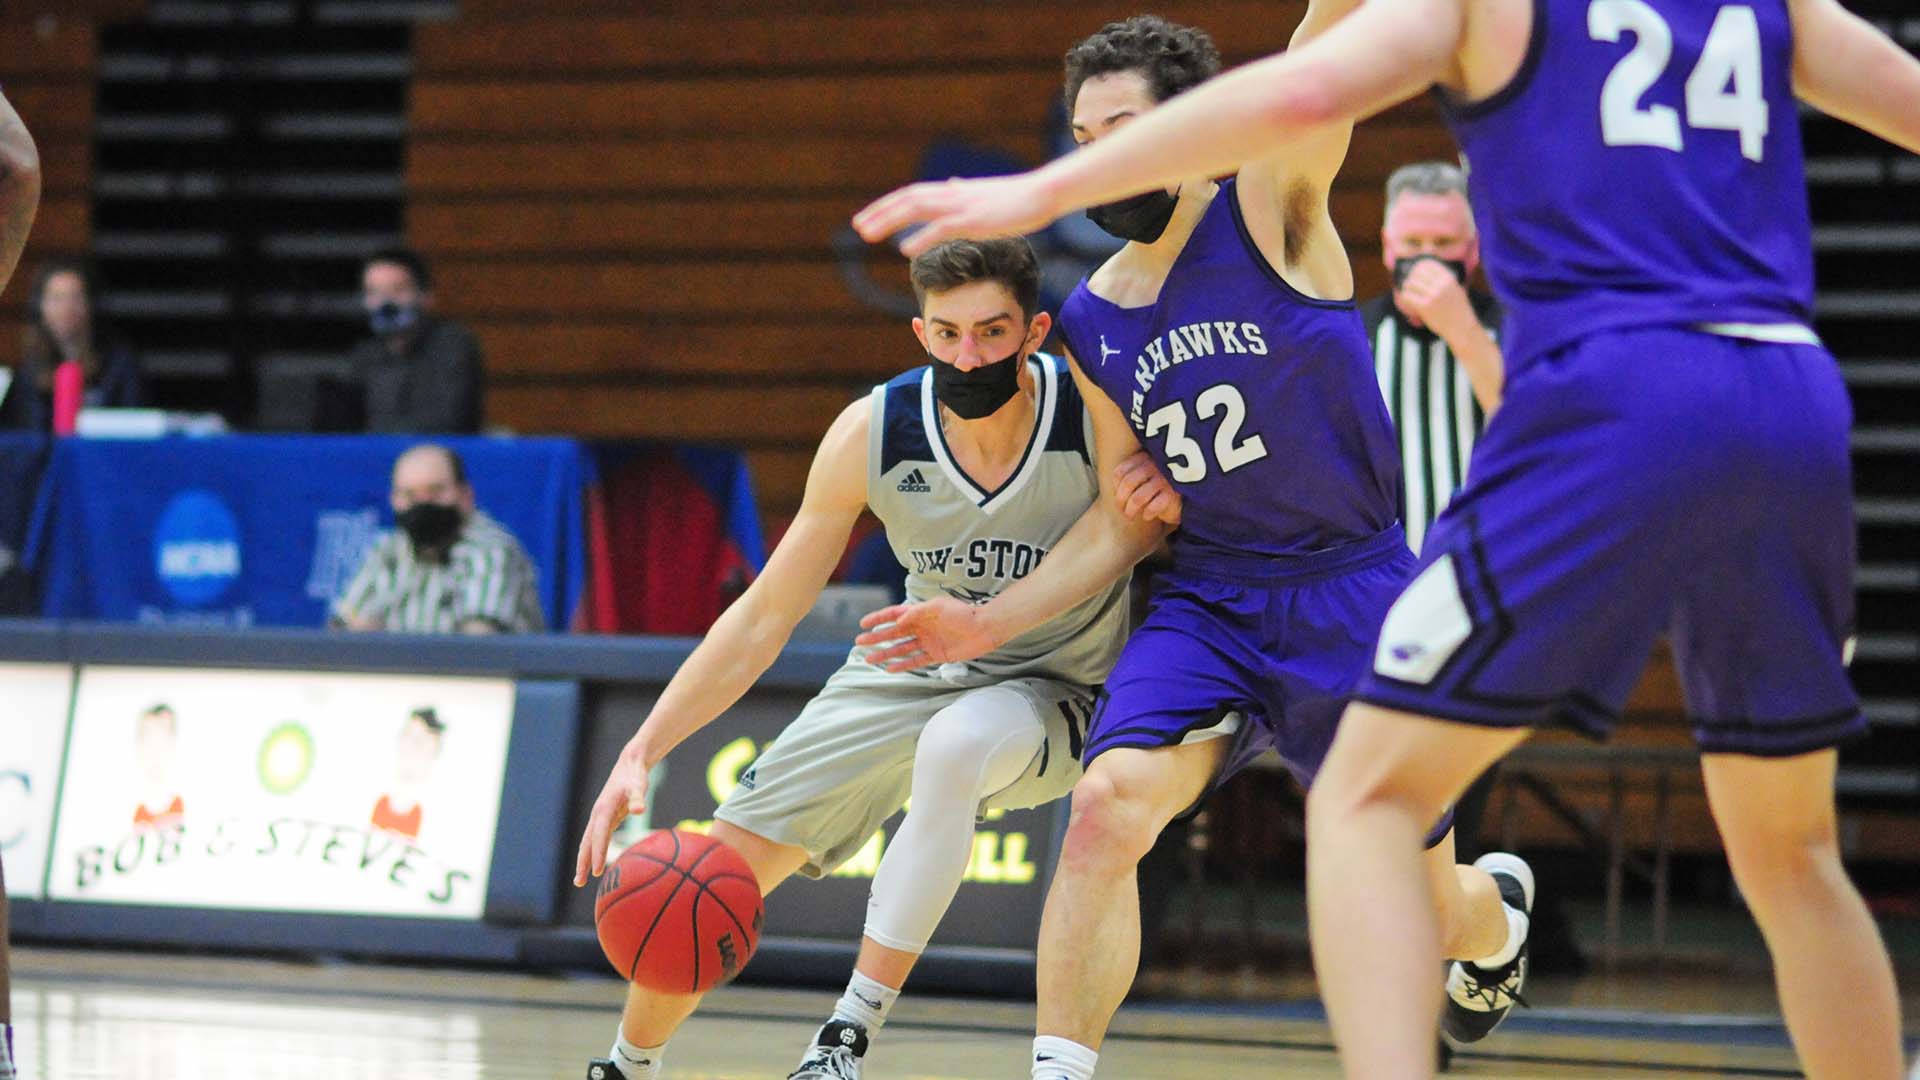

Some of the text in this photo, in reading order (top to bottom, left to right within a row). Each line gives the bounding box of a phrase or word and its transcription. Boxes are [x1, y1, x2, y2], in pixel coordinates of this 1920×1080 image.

[1587, 0, 1769, 162] 24
[1145, 383, 1268, 483] 32
[897, 484, 931, 492] adidas
[76, 823, 187, 888] BOB
